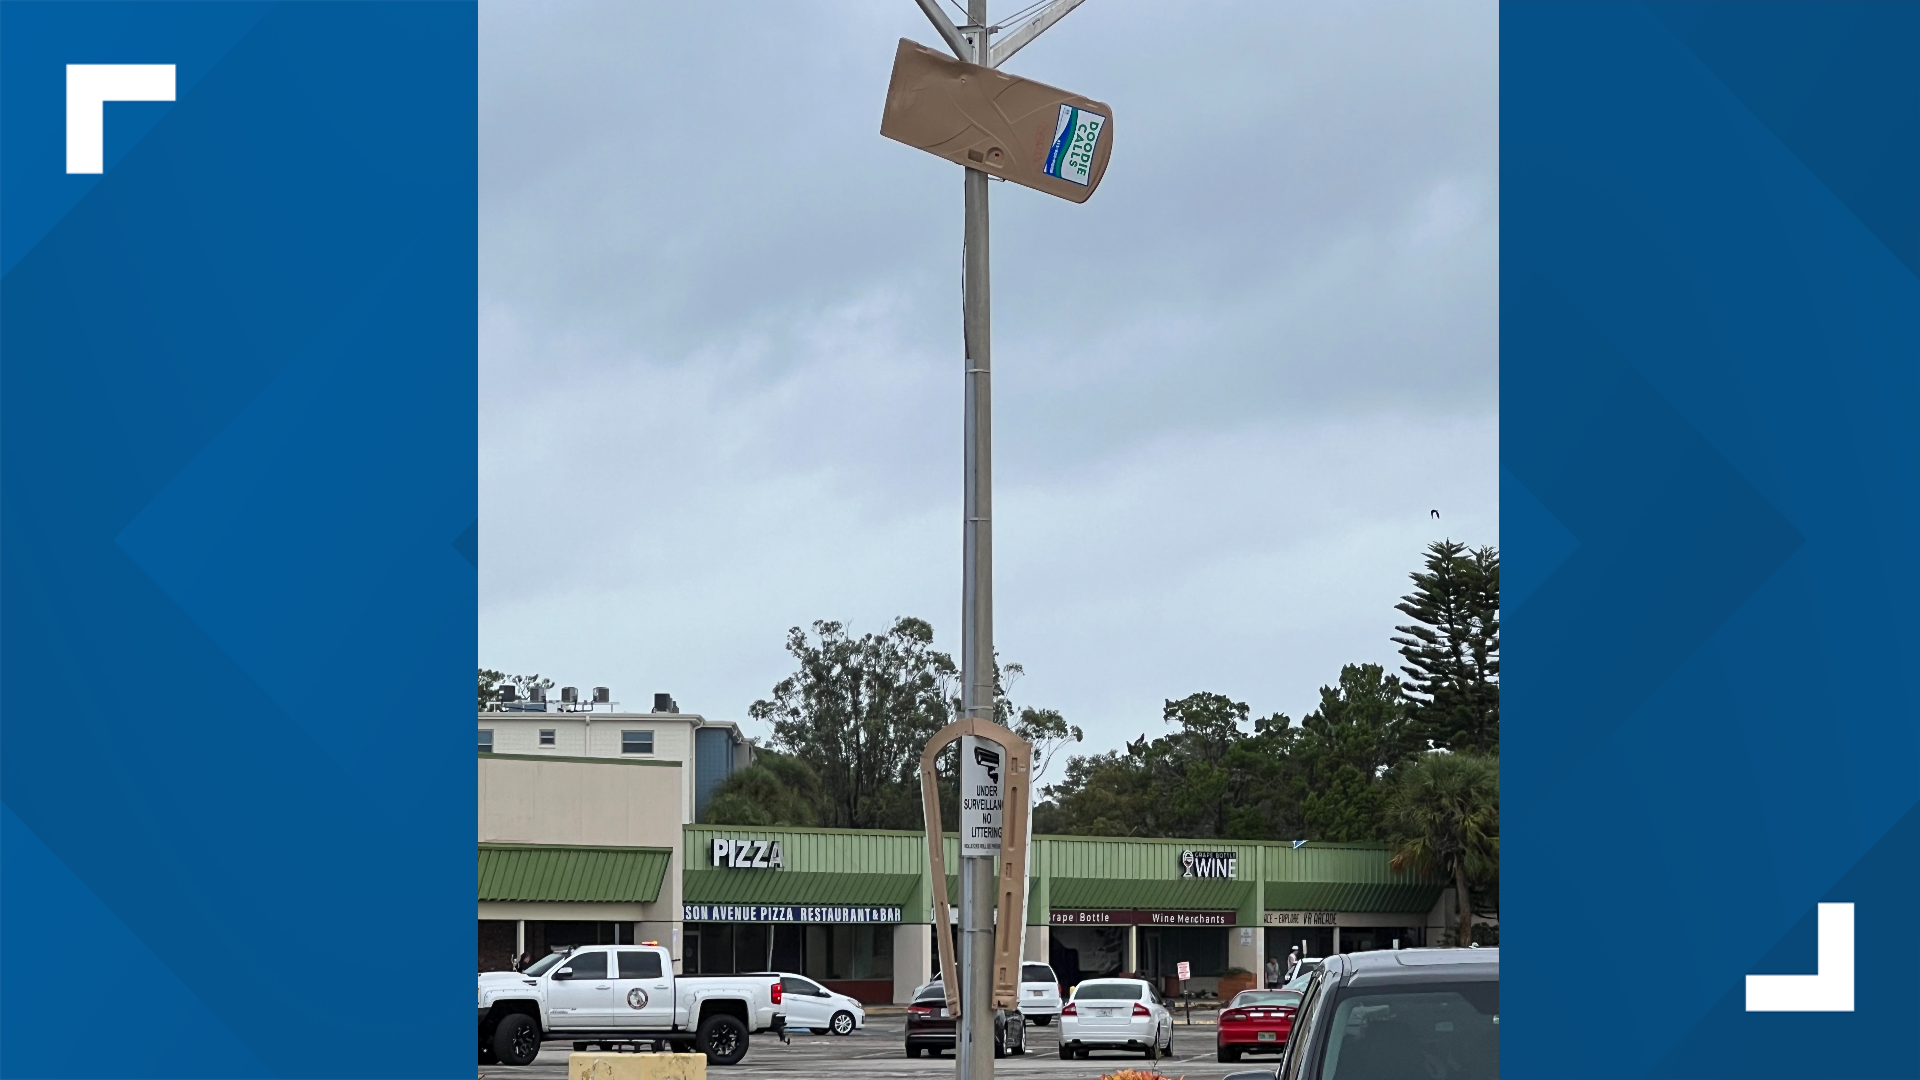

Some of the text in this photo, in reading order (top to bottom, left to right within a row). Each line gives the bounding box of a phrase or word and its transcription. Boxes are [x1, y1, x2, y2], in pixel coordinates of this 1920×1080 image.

[1069, 124, 1087, 167] CALLS
[1077, 121, 1099, 176] DOODIE
[976, 785, 998, 796] UNDER
[982, 812, 992, 825] NO
[971, 826, 1002, 838] LITTERING
[712, 838, 783, 868] PIZZA
[1195, 857, 1237, 878] WINE
[683, 905, 709, 920] SON
[712, 905, 757, 921] AVENUE
[760, 906, 794, 921] PIZZA
[1048, 912, 1110, 924] rape Bottle
[1152, 913, 1225, 924] Wine Merchants
